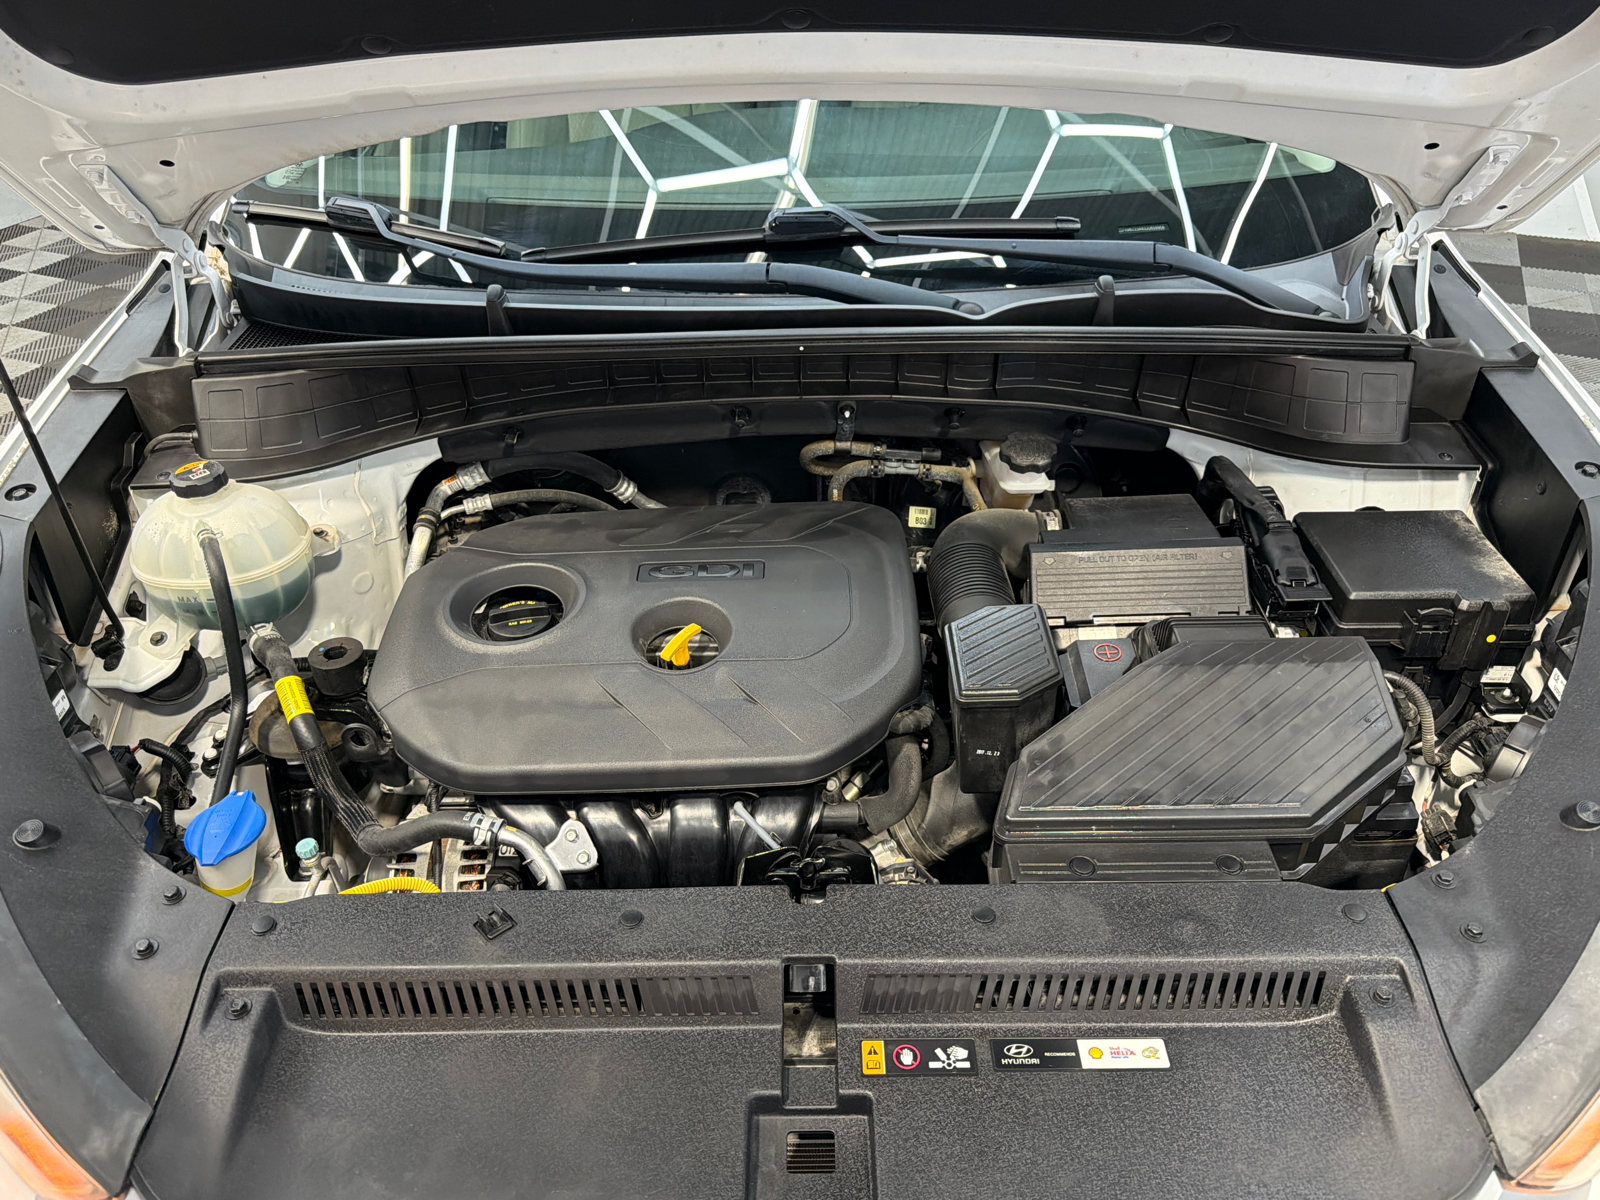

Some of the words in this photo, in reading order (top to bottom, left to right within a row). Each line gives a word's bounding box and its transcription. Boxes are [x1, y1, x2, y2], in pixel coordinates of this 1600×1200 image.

[1099, 555, 1115, 563] OUT
[1128, 554, 1149, 562] OPEN
[1151, 553, 1168, 562] (AIR
[648, 564, 755, 578] GDI
[177, 596, 199, 604] MAX
